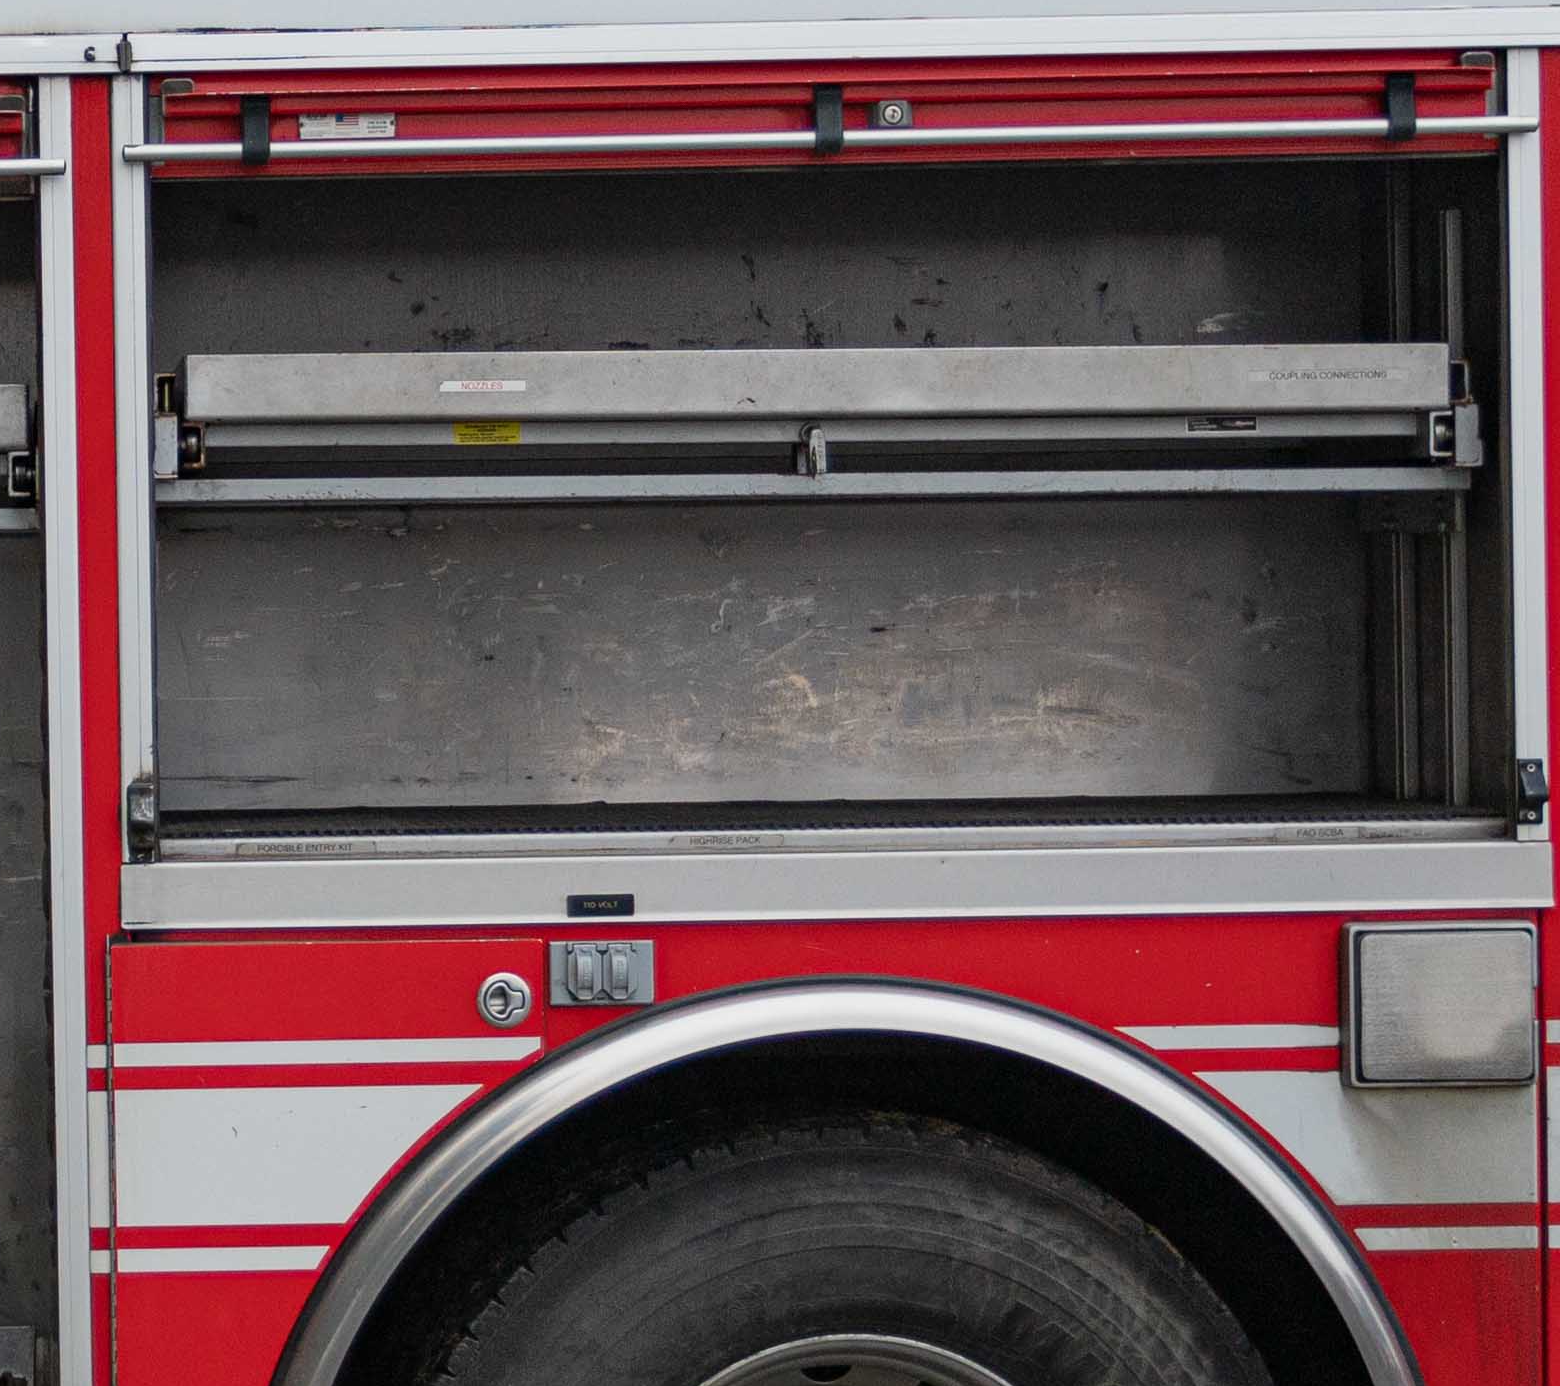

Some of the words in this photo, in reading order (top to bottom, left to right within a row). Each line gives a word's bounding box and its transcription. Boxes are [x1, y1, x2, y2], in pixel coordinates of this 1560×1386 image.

[1269, 370, 1318, 381] COUPLING
[1319, 369, 1388, 380] CONNECTIONS
[460, 380, 504, 390] NOZZLES
[689, 837, 734, 846] HIGHRISE
[735, 835, 761, 845] PACK
[583, 900, 597, 909] 110
[598, 900, 619, 909] VOLT
